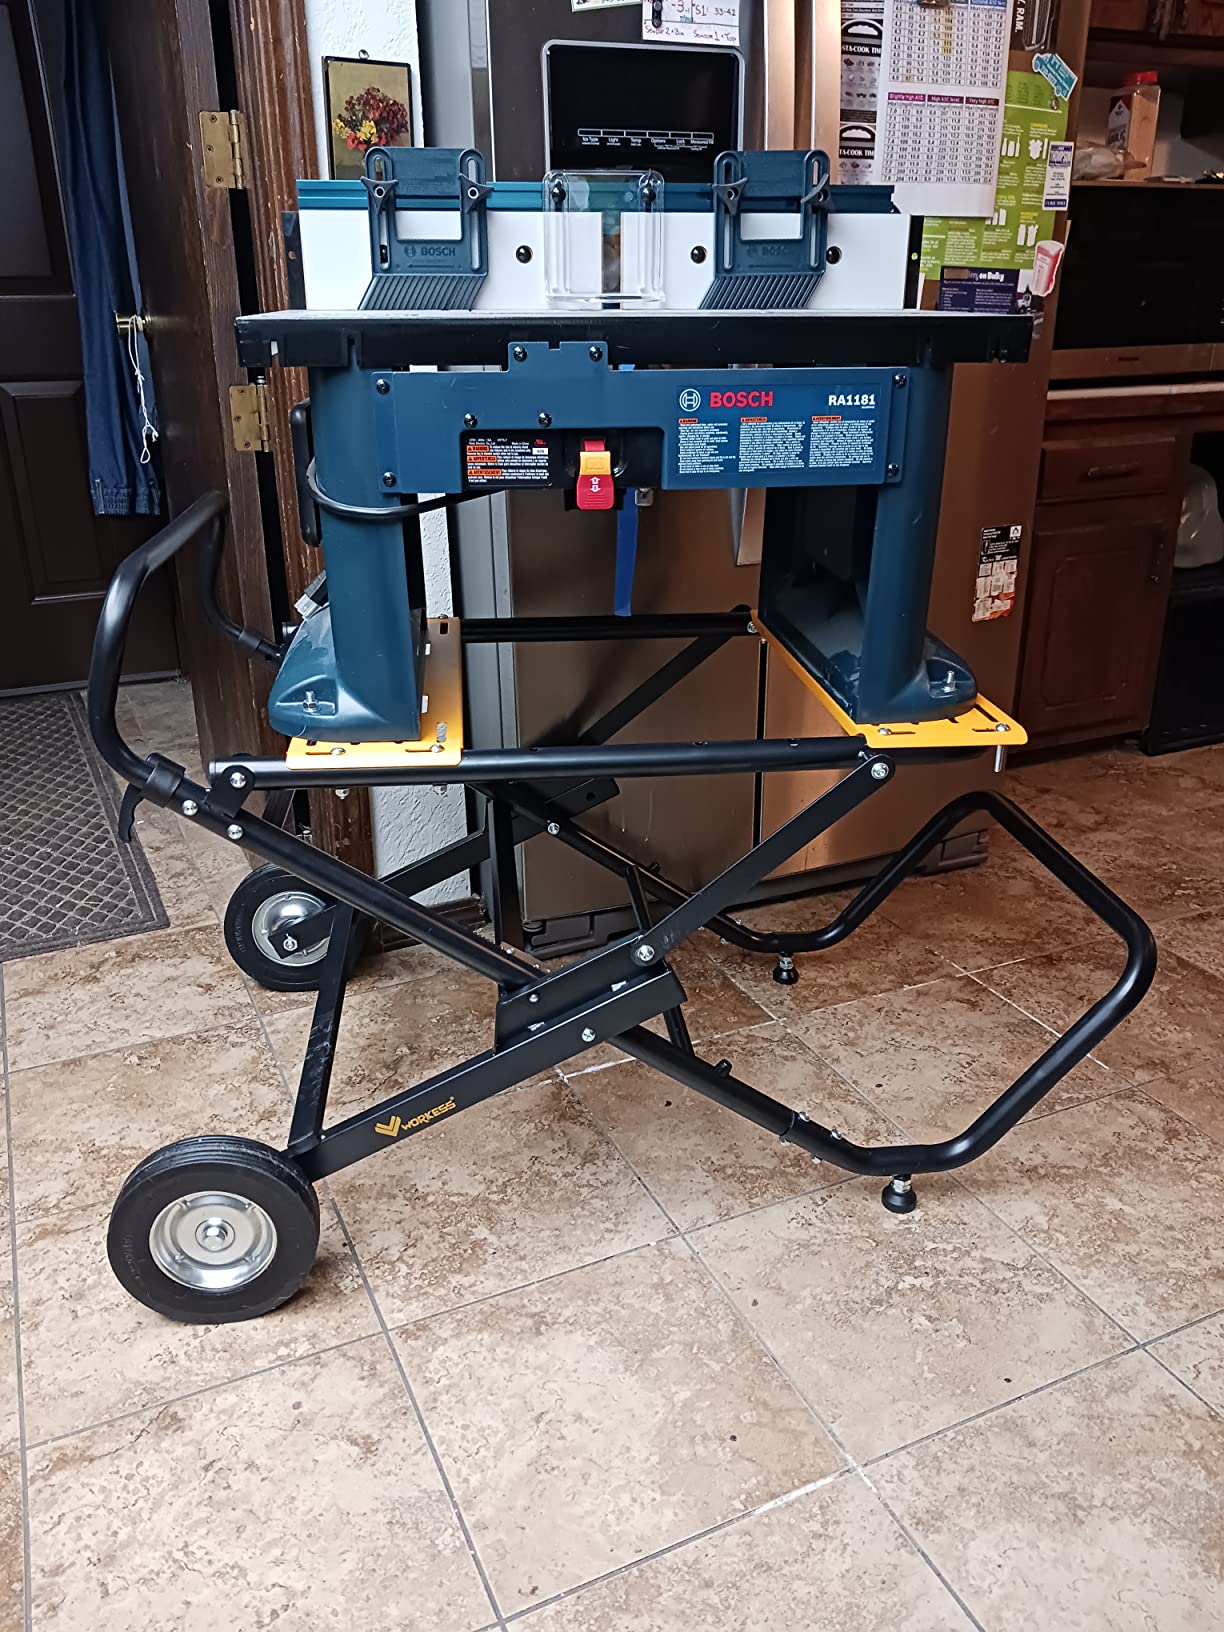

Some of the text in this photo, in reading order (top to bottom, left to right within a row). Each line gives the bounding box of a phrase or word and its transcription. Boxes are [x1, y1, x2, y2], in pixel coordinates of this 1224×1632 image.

[421, 247, 456, 256] BOSCH
[710, 392, 774, 407] BOSCH
[828, 394, 875, 406] RA1181
[401, 1100, 456, 1130] WORKESS
